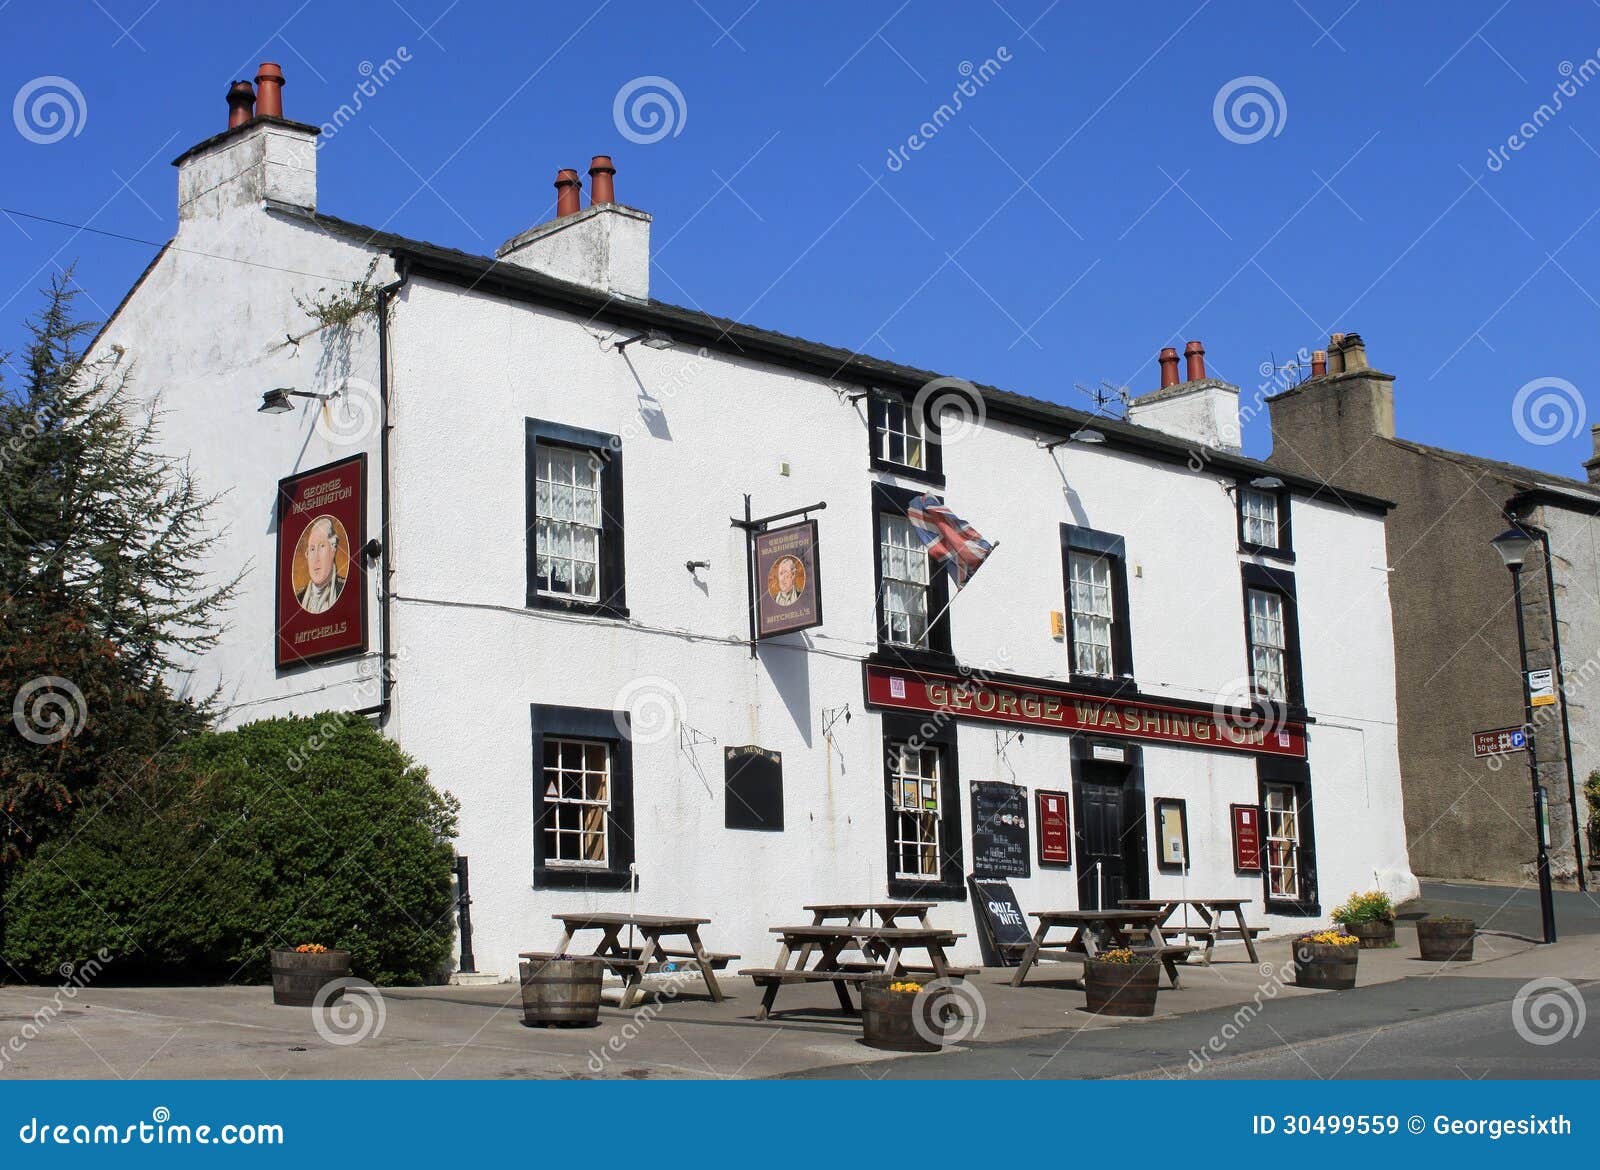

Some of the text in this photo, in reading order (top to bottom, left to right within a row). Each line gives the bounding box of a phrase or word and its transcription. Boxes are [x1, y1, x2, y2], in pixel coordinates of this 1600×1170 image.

[303, 478, 341, 499] GEORGE
[293, 486, 352, 514] WASHINGTON
[925, 679, 1267, 746] GEORGE WASHINGTON
[1477, 742, 1498, 752] 50 yds
[1480, 736, 1494, 744] Free
[988, 901, 1016, 917] QUIZ
[999, 913, 1022, 925] NITE
